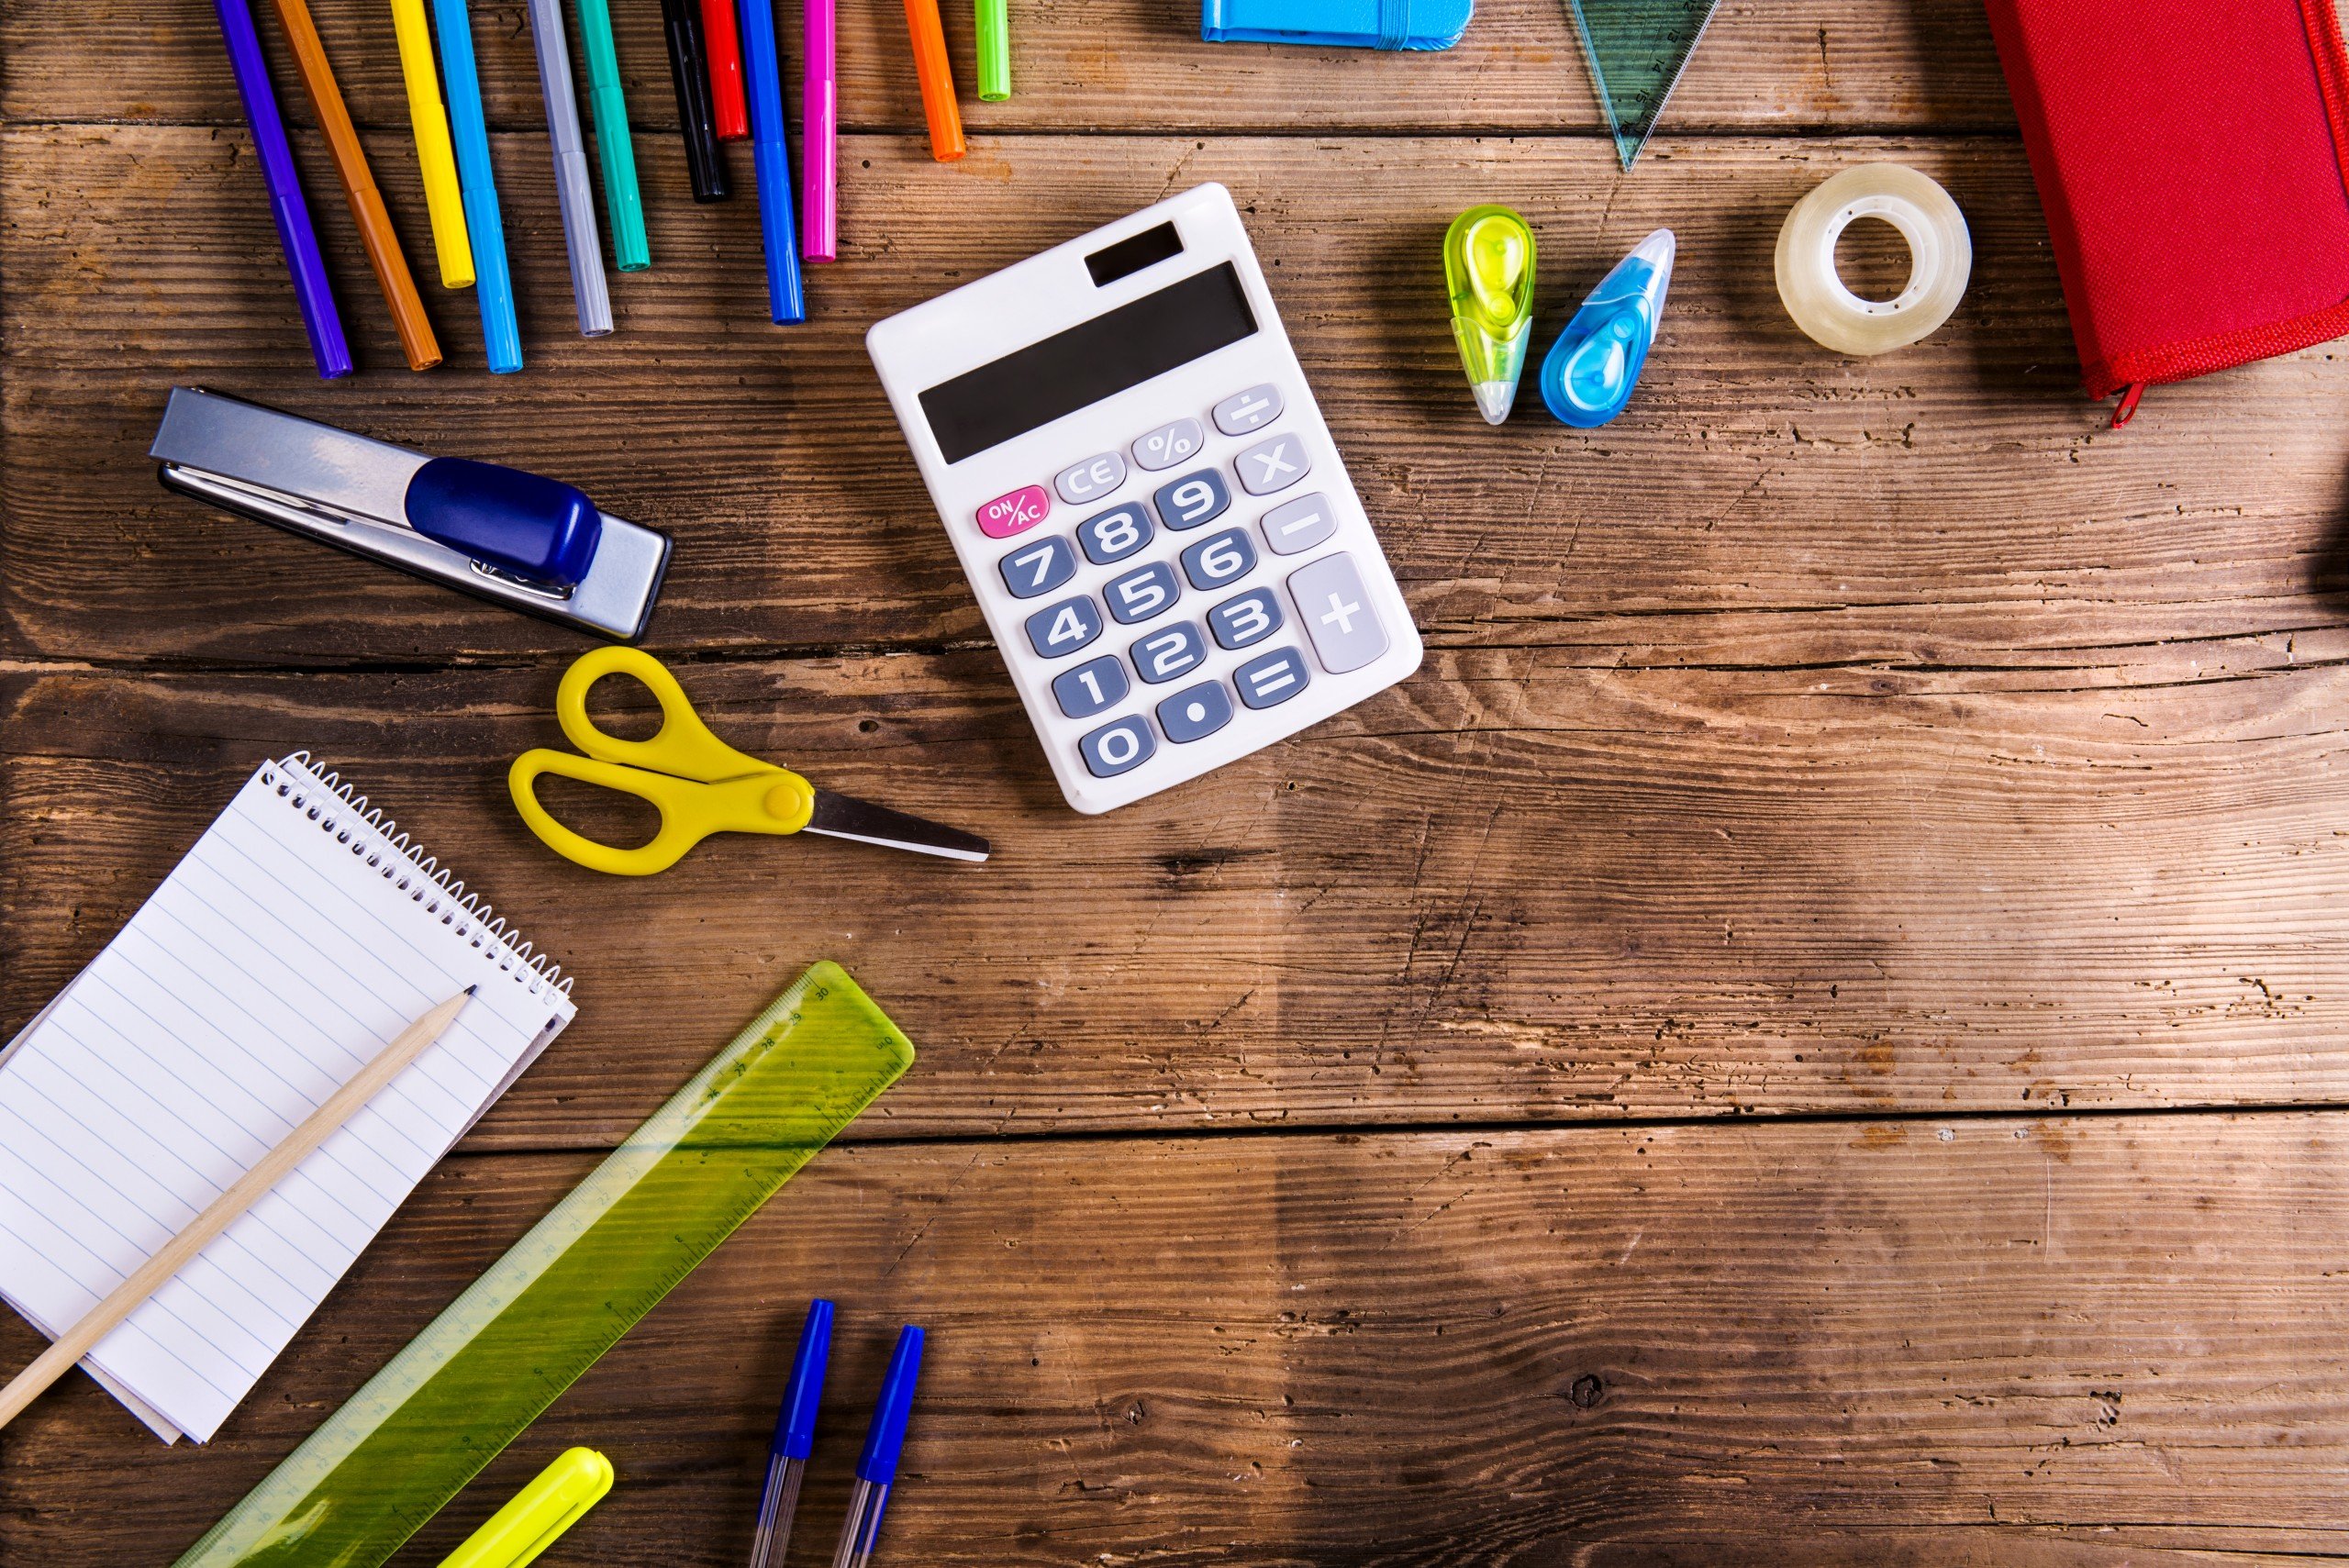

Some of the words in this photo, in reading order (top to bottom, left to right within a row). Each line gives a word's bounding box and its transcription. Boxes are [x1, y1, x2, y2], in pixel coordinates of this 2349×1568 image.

[1667, 28, 1681, 43] 13
[1653, 59, 1664, 73] 14
[1635, 89, 1650, 104] 15
[1620, 120, 1633, 134] 16
[1067, 459, 1114, 495] CE
[1015, 545, 1054, 587] 7
[1094, 512, 1140, 553] 8
[1172, 480, 1215, 522] 9
[1047, 606, 1088, 646] 4
[1118, 571, 1165, 617] 5
[1199, 537, 1243, 578] 6
[1078, 670, 1105, 705] 1
[1145, 632, 1195, 676] 2
[1222, 598, 1270, 642] 3
[1097, 728, 1140, 765] 0
[743, 1168, 752, 1177] 2
[674, 1233, 683, 1242] 3
[258, 1512, 272, 1525] 10
[373, 1403, 387, 1417] 14
[402, 1376, 416, 1389] 15
[430, 1349, 444, 1362] 16
[459, 1322, 472, 1336] 17
[486, 1296, 500, 1309] 18
[514, 1270, 528, 1284] 19
[542, 1244, 556, 1258] 20
[569, 1218, 583, 1232] 21
[596, 1192, 611, 1206] 22
[626, 1166, 639, 1181] 23
[734, 1062, 747, 1077] 27
[761, 1037, 775, 1051] 28
[788, 1012, 802, 1026] 29
[815, 987, 829, 1002] 30
[605, 1301, 613, 1310] 4
[533, 1367, 543, 1377] 5
